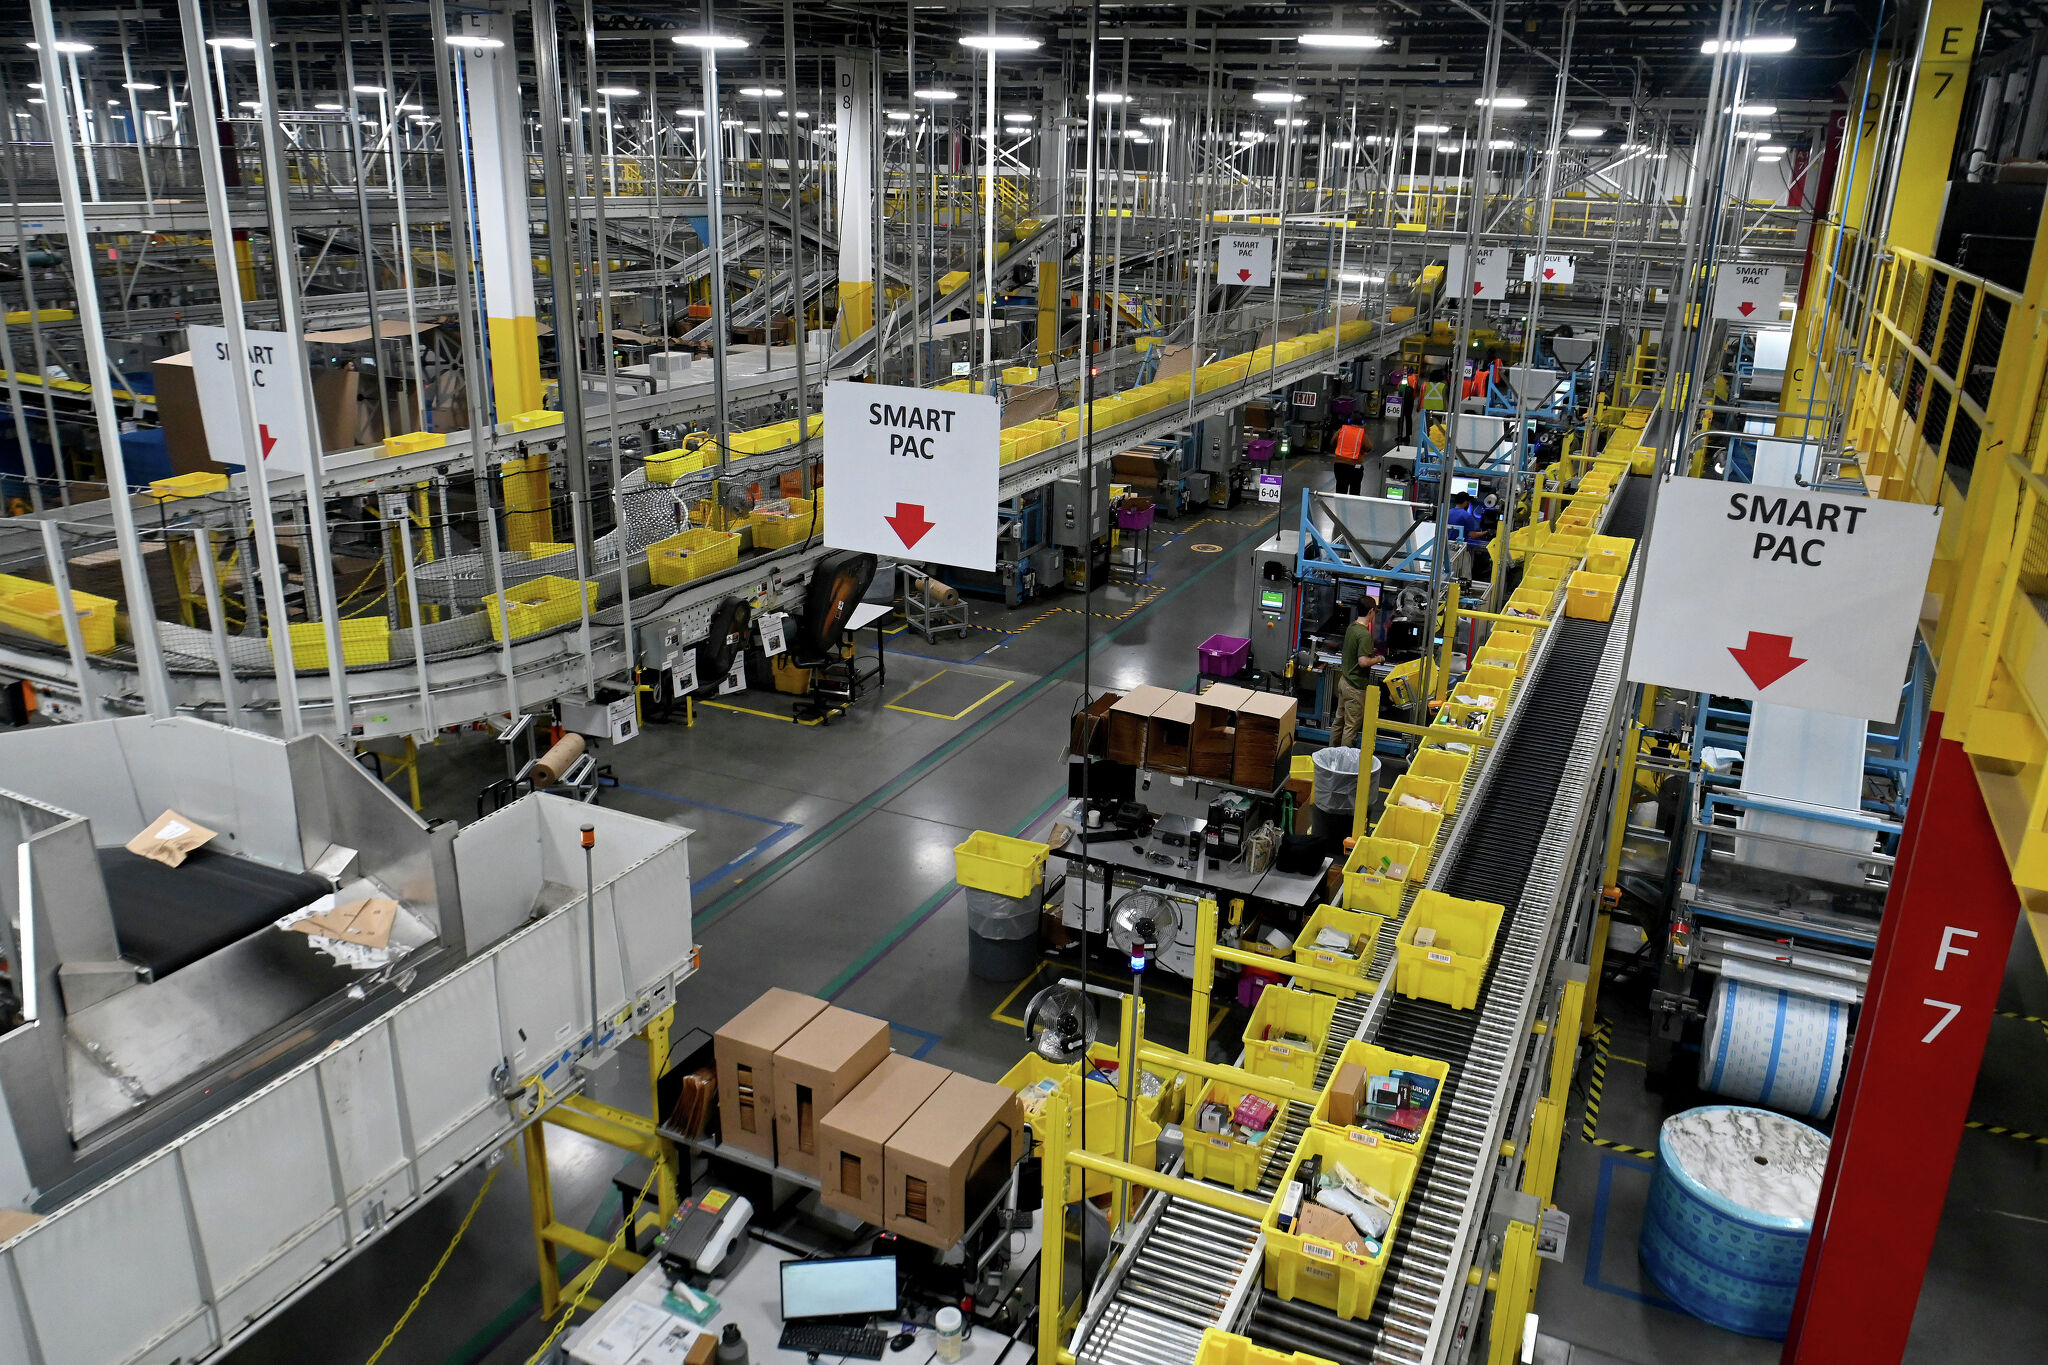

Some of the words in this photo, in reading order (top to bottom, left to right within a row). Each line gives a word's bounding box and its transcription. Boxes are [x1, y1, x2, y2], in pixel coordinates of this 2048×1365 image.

[1940, 27, 1963, 54] E
[842, 73, 851, 87] D
[1933, 72, 1954, 99] 7
[843, 95, 851, 109] 8
[1864, 120, 1877, 137] 7
[1232, 241, 1259, 249] SMART
[1736, 266, 1769, 276] SMART
[1742, 276, 1760, 285] PAC
[216, 342, 273, 365] SRT
[1793, 368, 1804, 382] C
[1297, 393, 1313, 405] EXIT
[869, 402, 956, 433] SMART
[890, 433, 935, 460] PAC
[1261, 488, 1279, 499] 6-04
[1727, 492, 1867, 534] SMART
[1752, 532, 1826, 567] PAC
[1934, 925, 1979, 971] F
[1921, 998, 1962, 1044] 7
